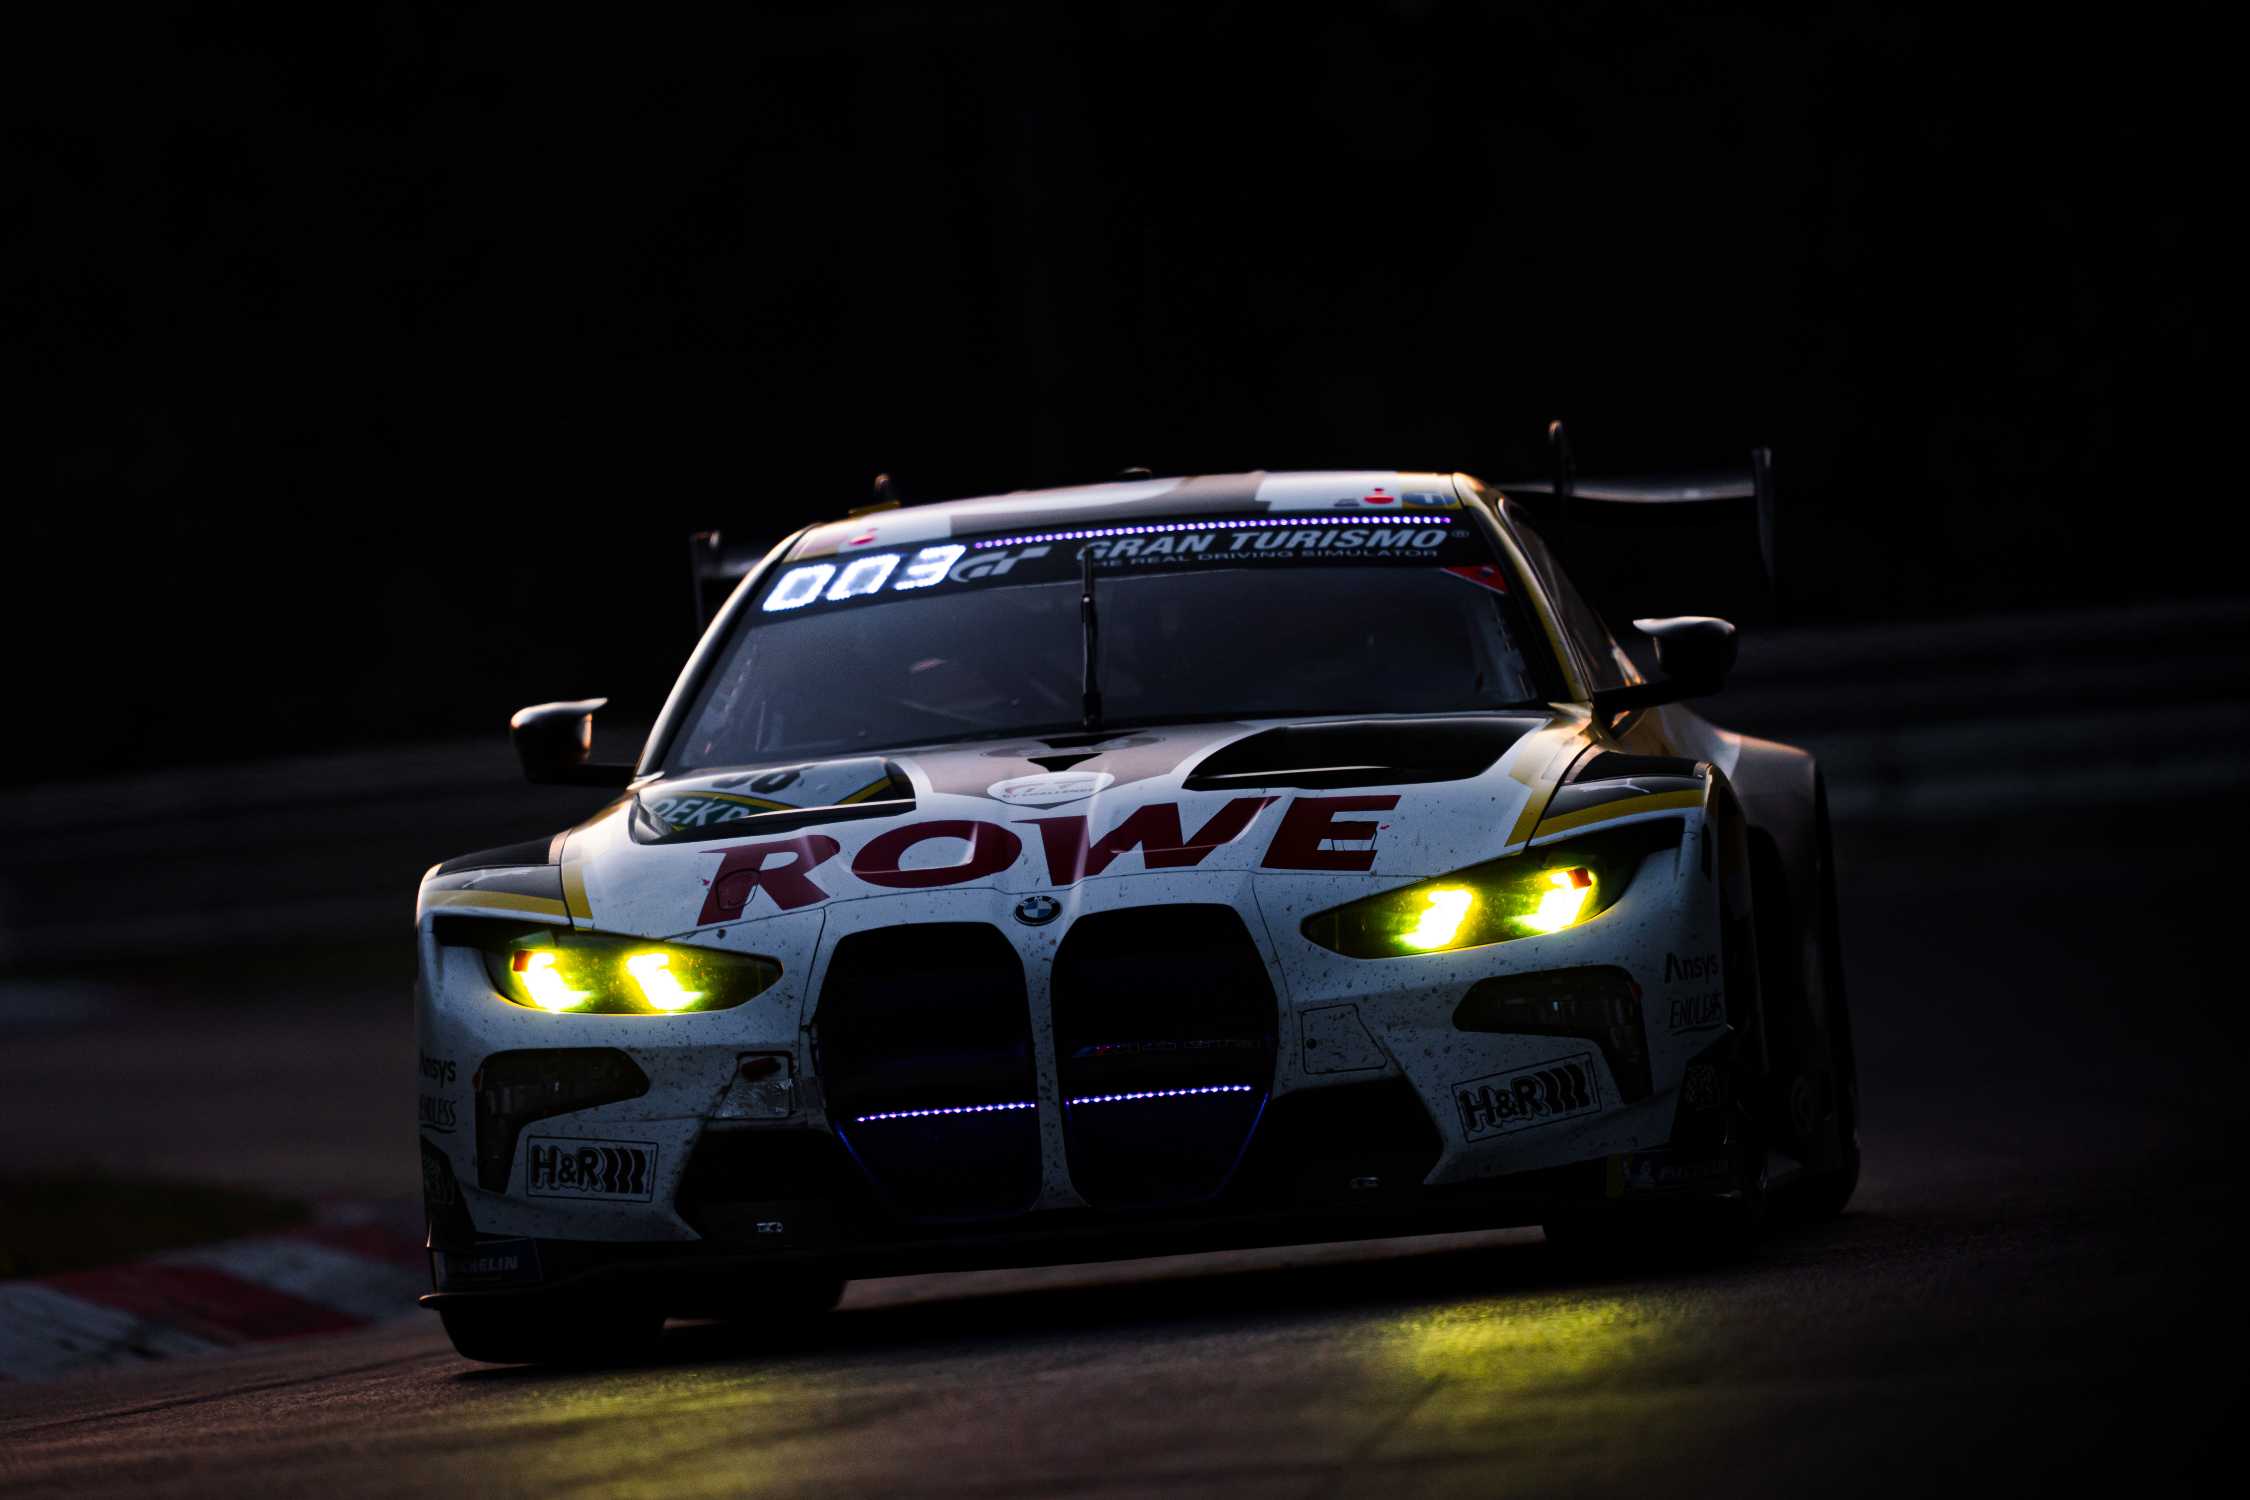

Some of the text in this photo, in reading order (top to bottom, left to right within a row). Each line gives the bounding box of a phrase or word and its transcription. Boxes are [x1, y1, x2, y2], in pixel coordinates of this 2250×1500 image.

[1076, 529, 1448, 560] GRAN TURISMO
[1130, 554, 1189, 567] REAL
[1198, 550, 1294, 562] DRIVING
[1299, 549, 1438, 559] SIMULATOR
[653, 799, 750, 827] DEKR
[697, 795, 1400, 926] ROWE
[1664, 952, 1719, 984] Ansys
